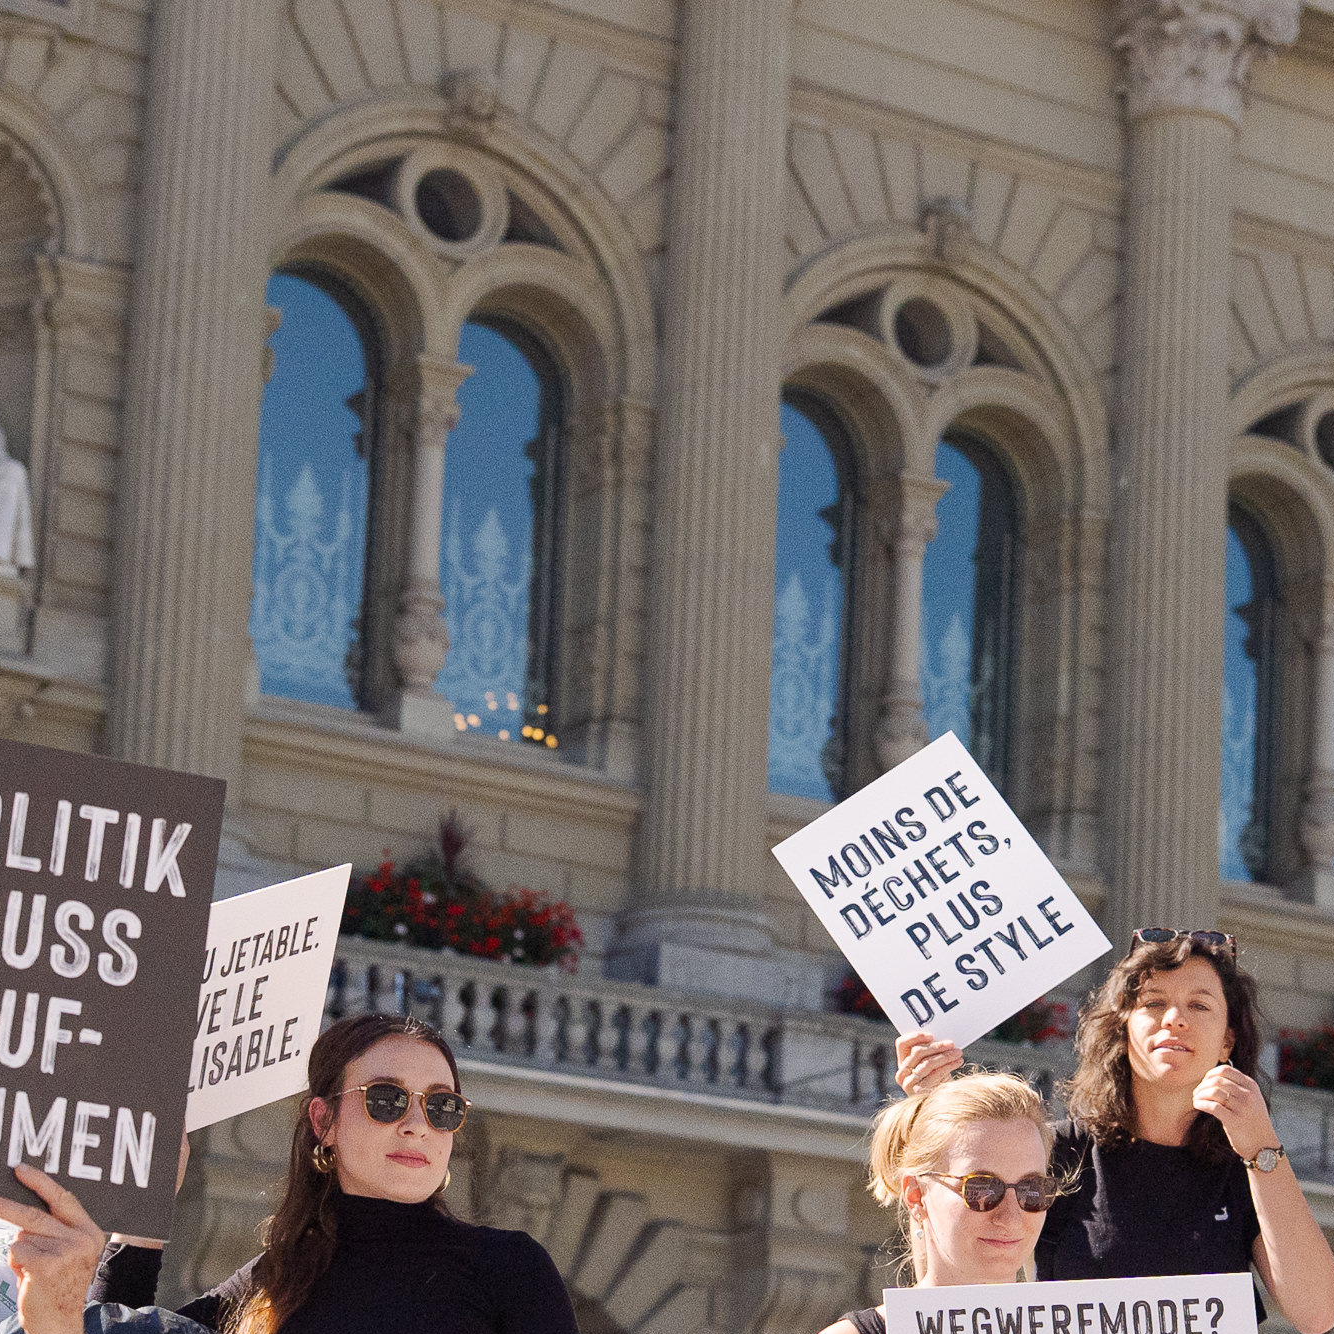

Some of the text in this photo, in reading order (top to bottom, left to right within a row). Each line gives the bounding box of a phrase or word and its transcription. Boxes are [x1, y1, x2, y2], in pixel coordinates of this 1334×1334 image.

[809, 770, 981, 901] MOINS DE
[839, 819, 1012, 941] DÉCHETS,
[220, 916, 320, 979] JETABLE.
[900, 895, 1075, 1028] DE STYLE
[904, 879, 1003, 961] PLUS
[232, 975, 269, 1027] LE
